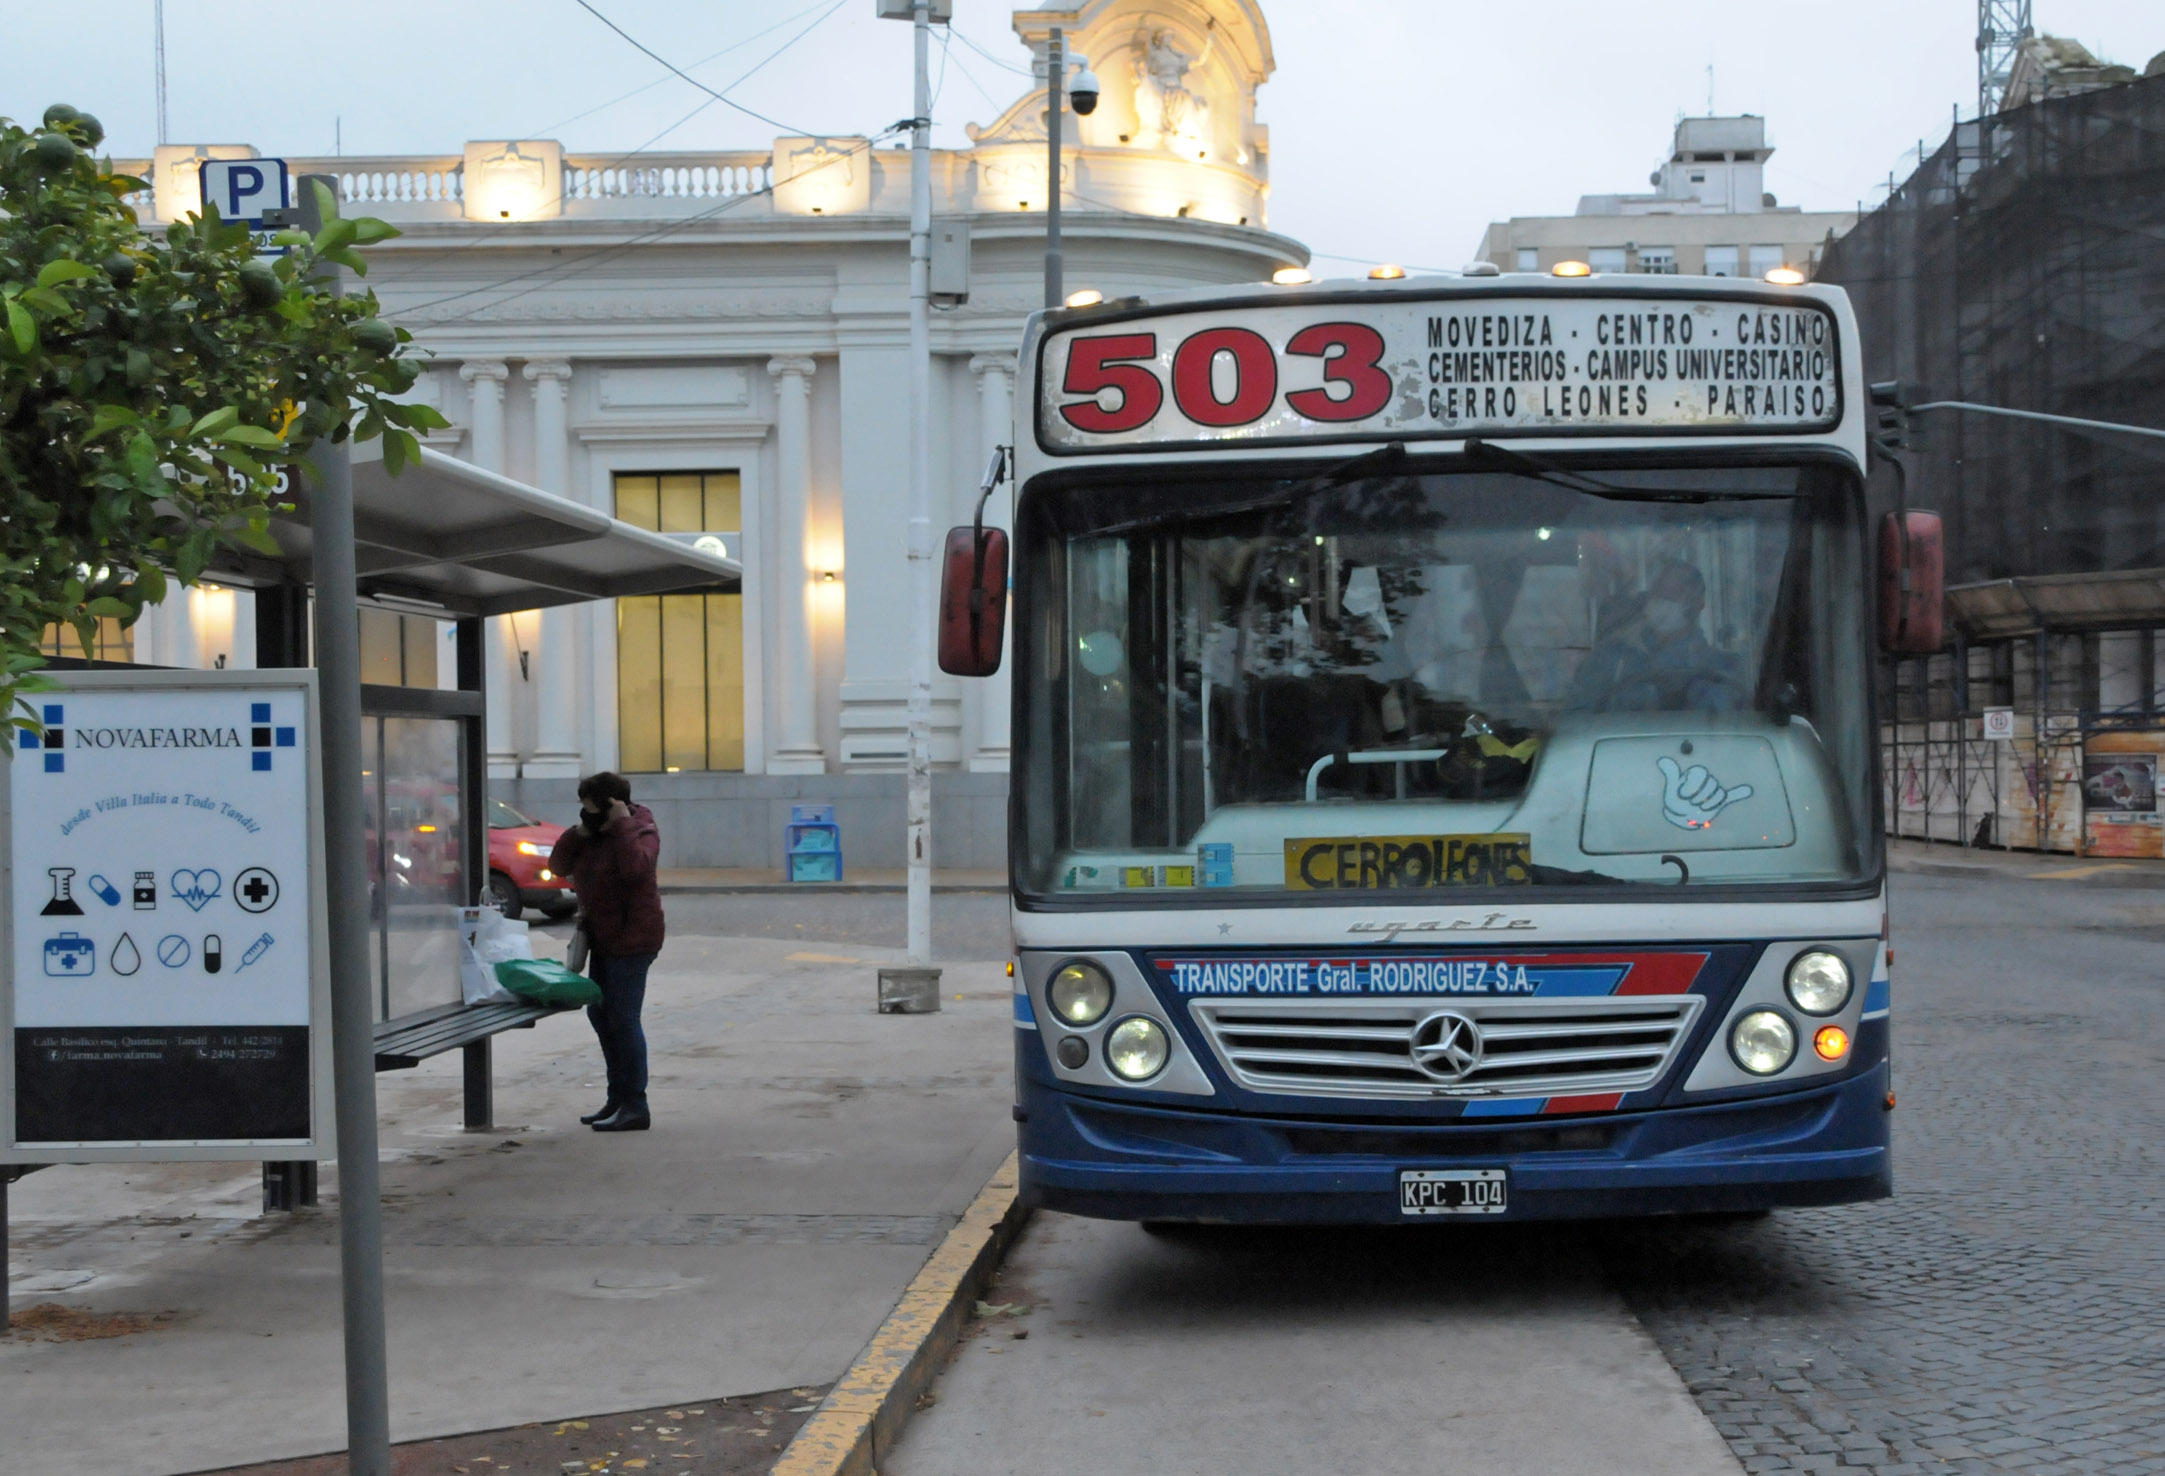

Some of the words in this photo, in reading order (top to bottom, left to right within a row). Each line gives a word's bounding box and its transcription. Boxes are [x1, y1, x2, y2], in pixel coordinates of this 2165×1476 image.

[228, 165, 264, 216] P
[1428, 315, 1553, 348] MOVEDIZA
[1597, 313, 1693, 345] CENTRO
[1737, 312, 1825, 345] CASINO
[1059, 322, 1392, 433] 503
[1429, 350, 1566, 383] CEMENTERIOS
[1587, 349, 1668, 381] CAMPUS
[1676, 349, 1825, 381] UNIVERSITARIO
[1428, 387, 1516, 419] CERRO
[1544, 384, 1648, 417] LEONES
[1708, 384, 1825, 417] PARAISO
[75, 728, 241, 748] NOVAFARMA
[61, 808, 92, 836] desde
[95, 796, 128, 813] Villa
[132, 792, 167, 806] Italia
[171, 796, 179, 805] a
[184, 793, 216, 811] Todo
[219, 802, 261, 834] Tandil
[1175, 962, 1310, 993] TRANSPORTE
[1316, 963, 1363, 993] Gral.
[1370, 962, 1489, 992] RODRIGUEZ
[1494, 962, 1535, 992] S.A.
[1404, 1182, 1446, 1206] KPC
[1460, 1180, 1503, 1205] 104
